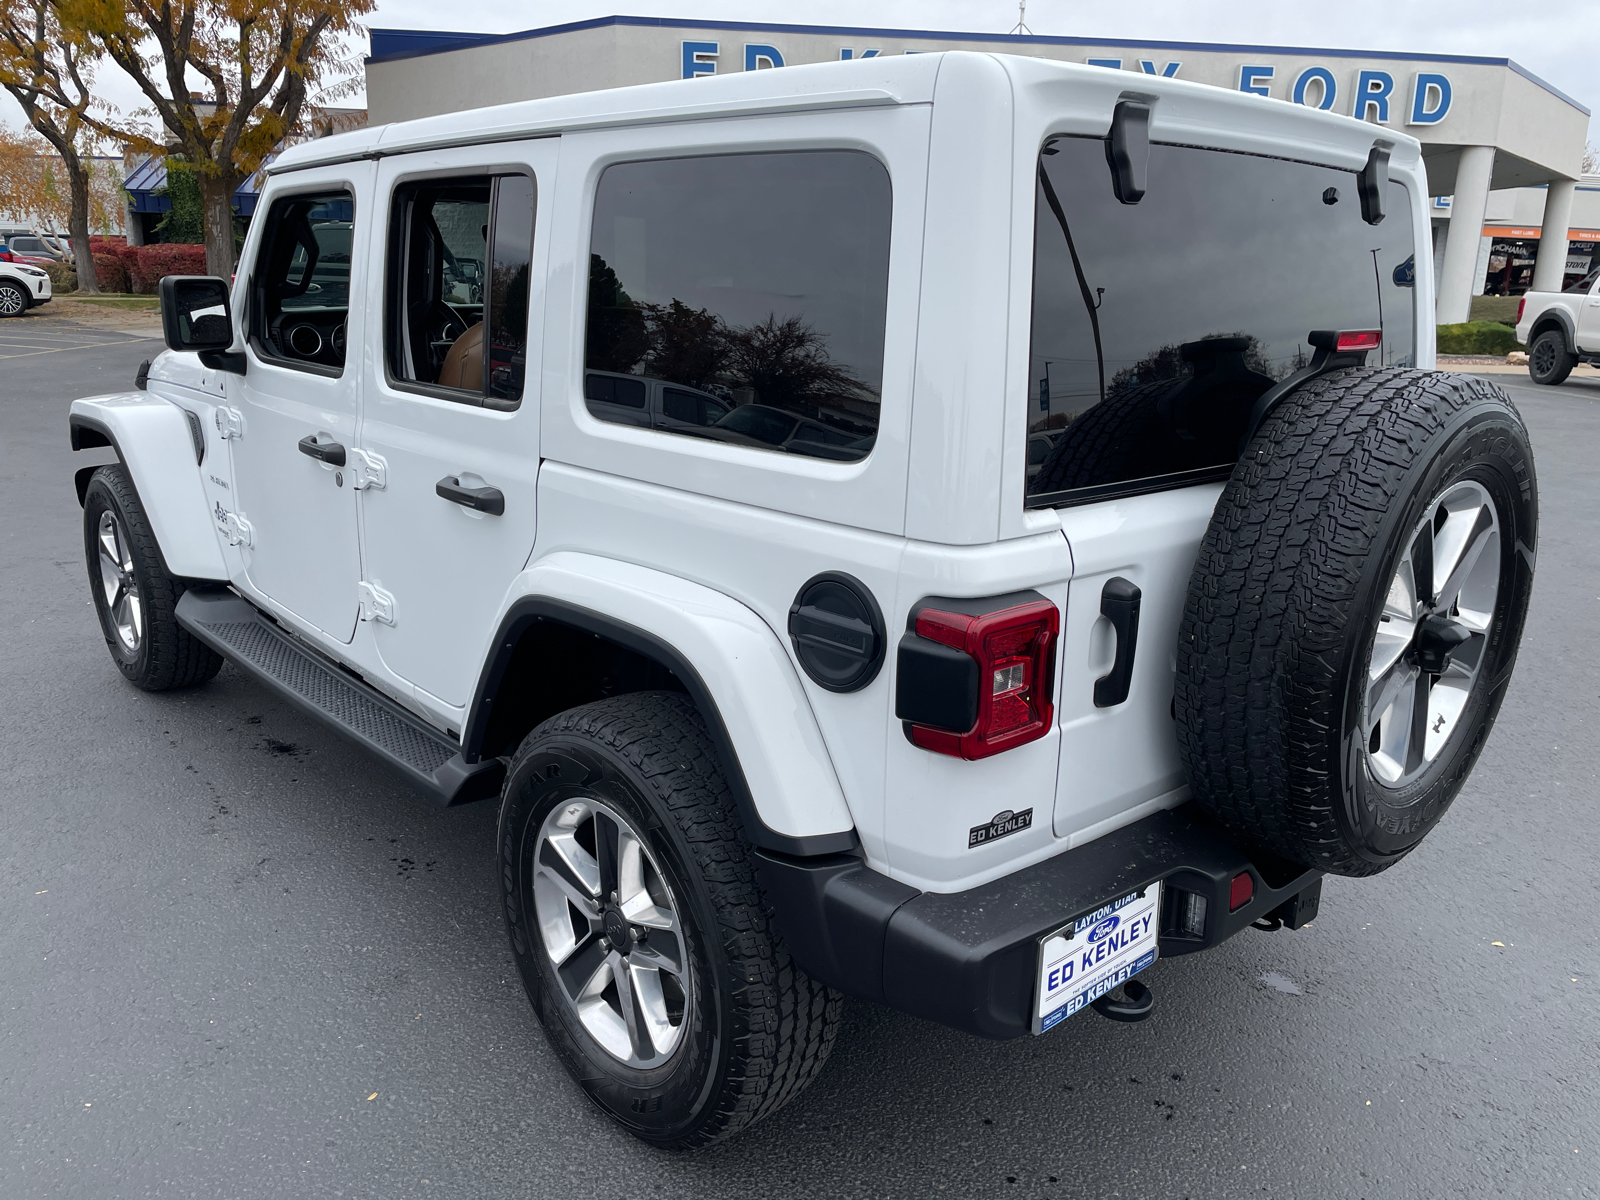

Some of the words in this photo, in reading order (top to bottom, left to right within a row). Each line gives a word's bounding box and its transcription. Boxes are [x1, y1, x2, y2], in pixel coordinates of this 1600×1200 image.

[834, 633, 859, 646] FUEL
[970, 829, 986, 844] ED
[989, 813, 1032, 838] KENLEY
[1074, 904, 1114, 933] LAYTON,
[1093, 920, 1114, 941] Ford
[1048, 960, 1075, 992] ED
[1082, 912, 1153, 972] KENLEY
[1066, 995, 1084, 1016] ED
[1087, 966, 1133, 1004] KENLEY
